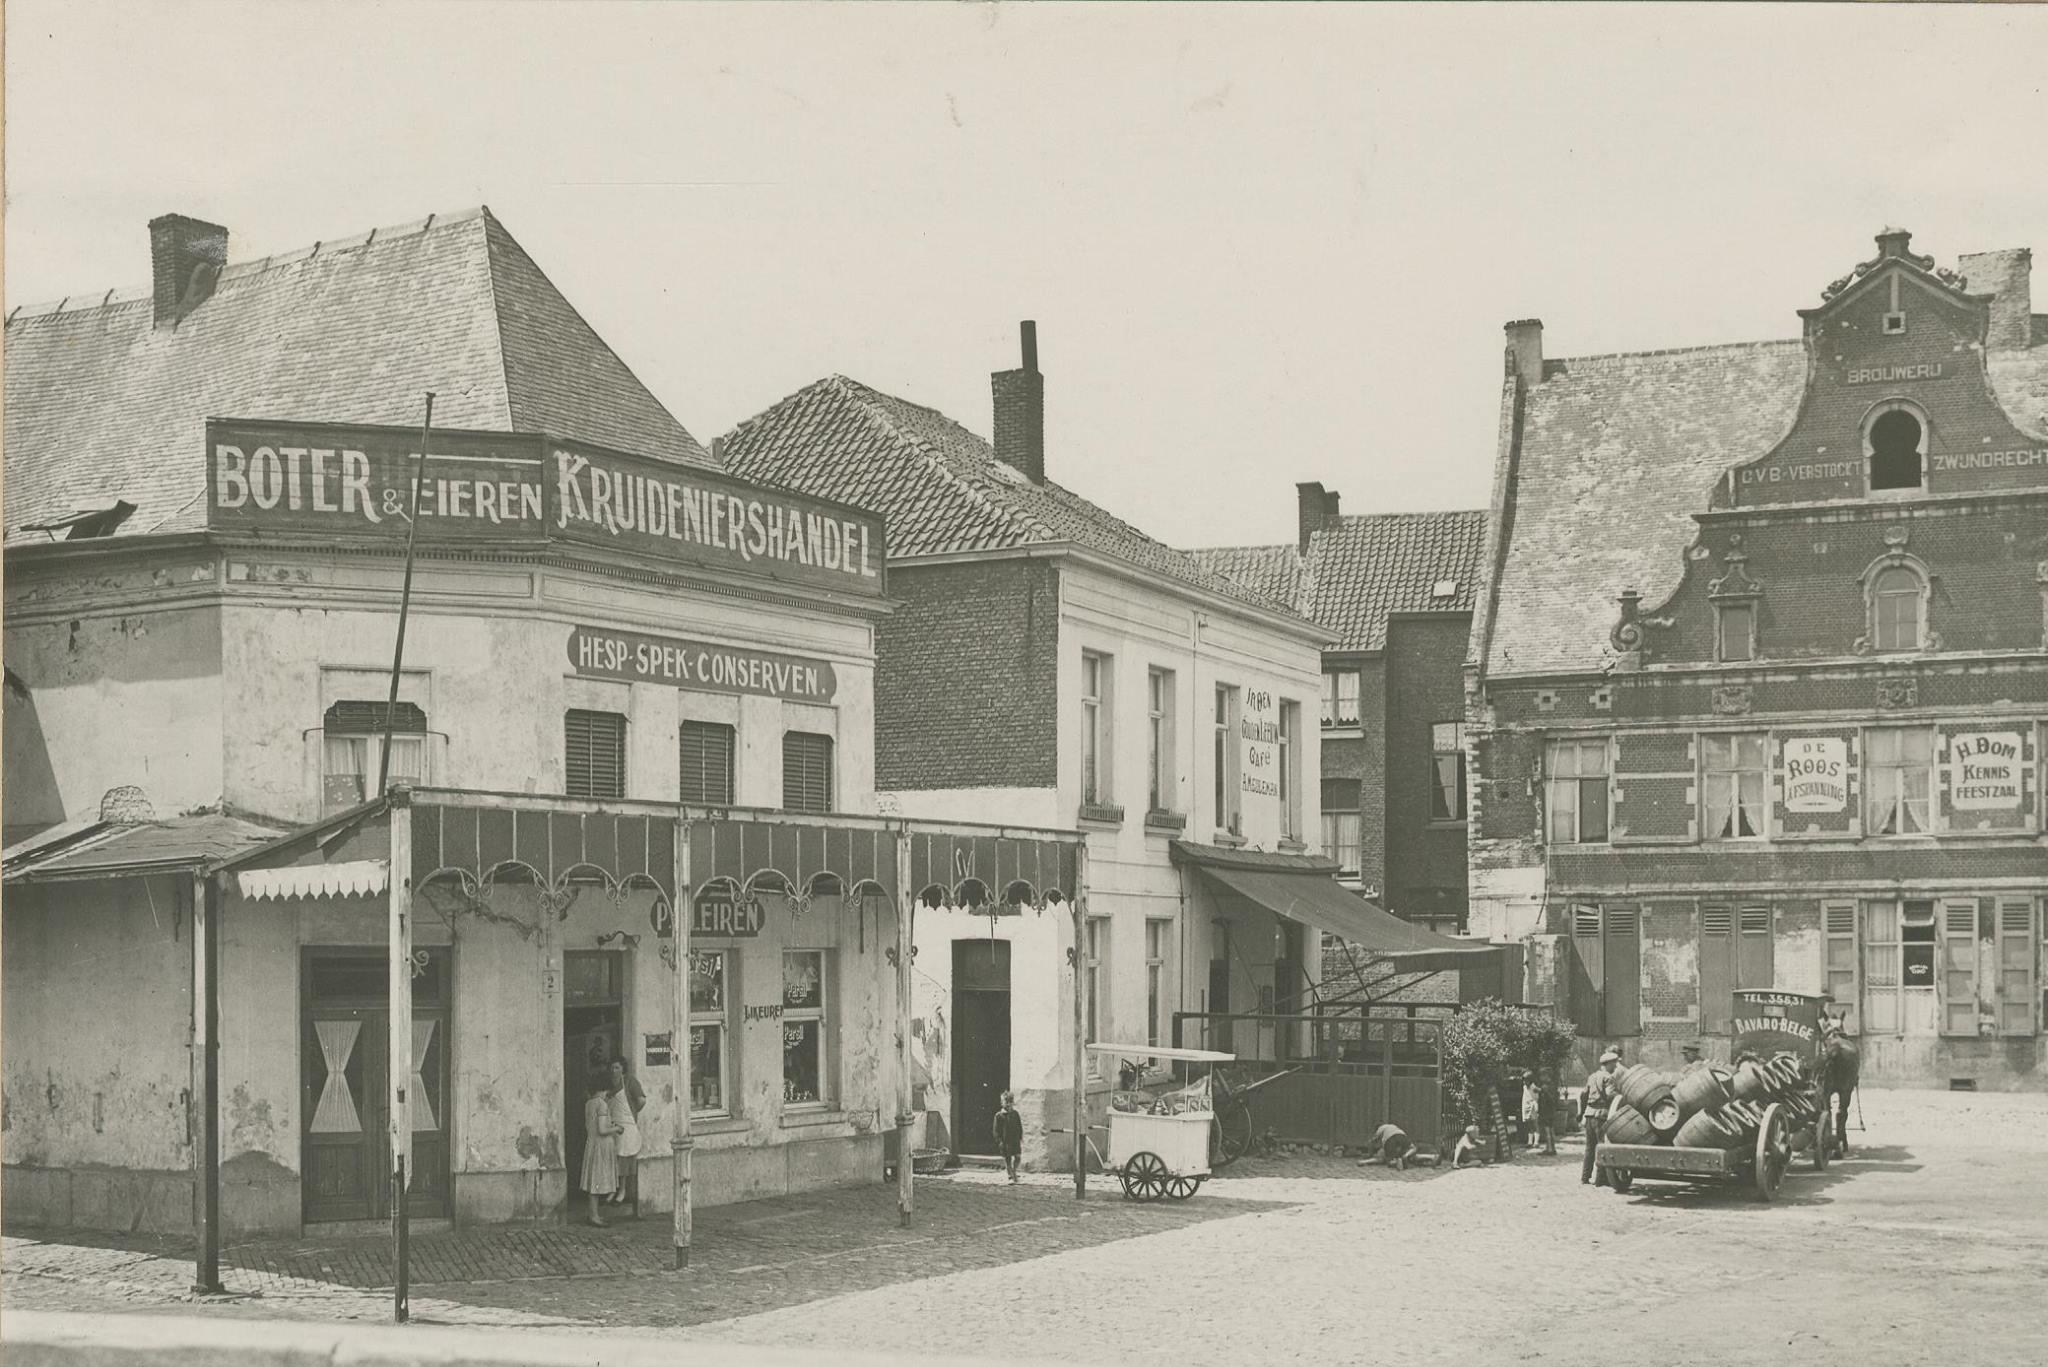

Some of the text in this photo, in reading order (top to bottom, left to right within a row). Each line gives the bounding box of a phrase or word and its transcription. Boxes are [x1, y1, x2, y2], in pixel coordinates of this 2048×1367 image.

[215, 444, 543, 524] BOTER & EIEREN
[553, 449, 876, 578] KRUIDENIERSHANDEL
[1803, 743, 1826, 753] DE
[1787, 759, 1841, 780] ROOS
[1956, 785, 2019, 799] FEESTZAAL
[682, 902, 758, 935] LEIREN
